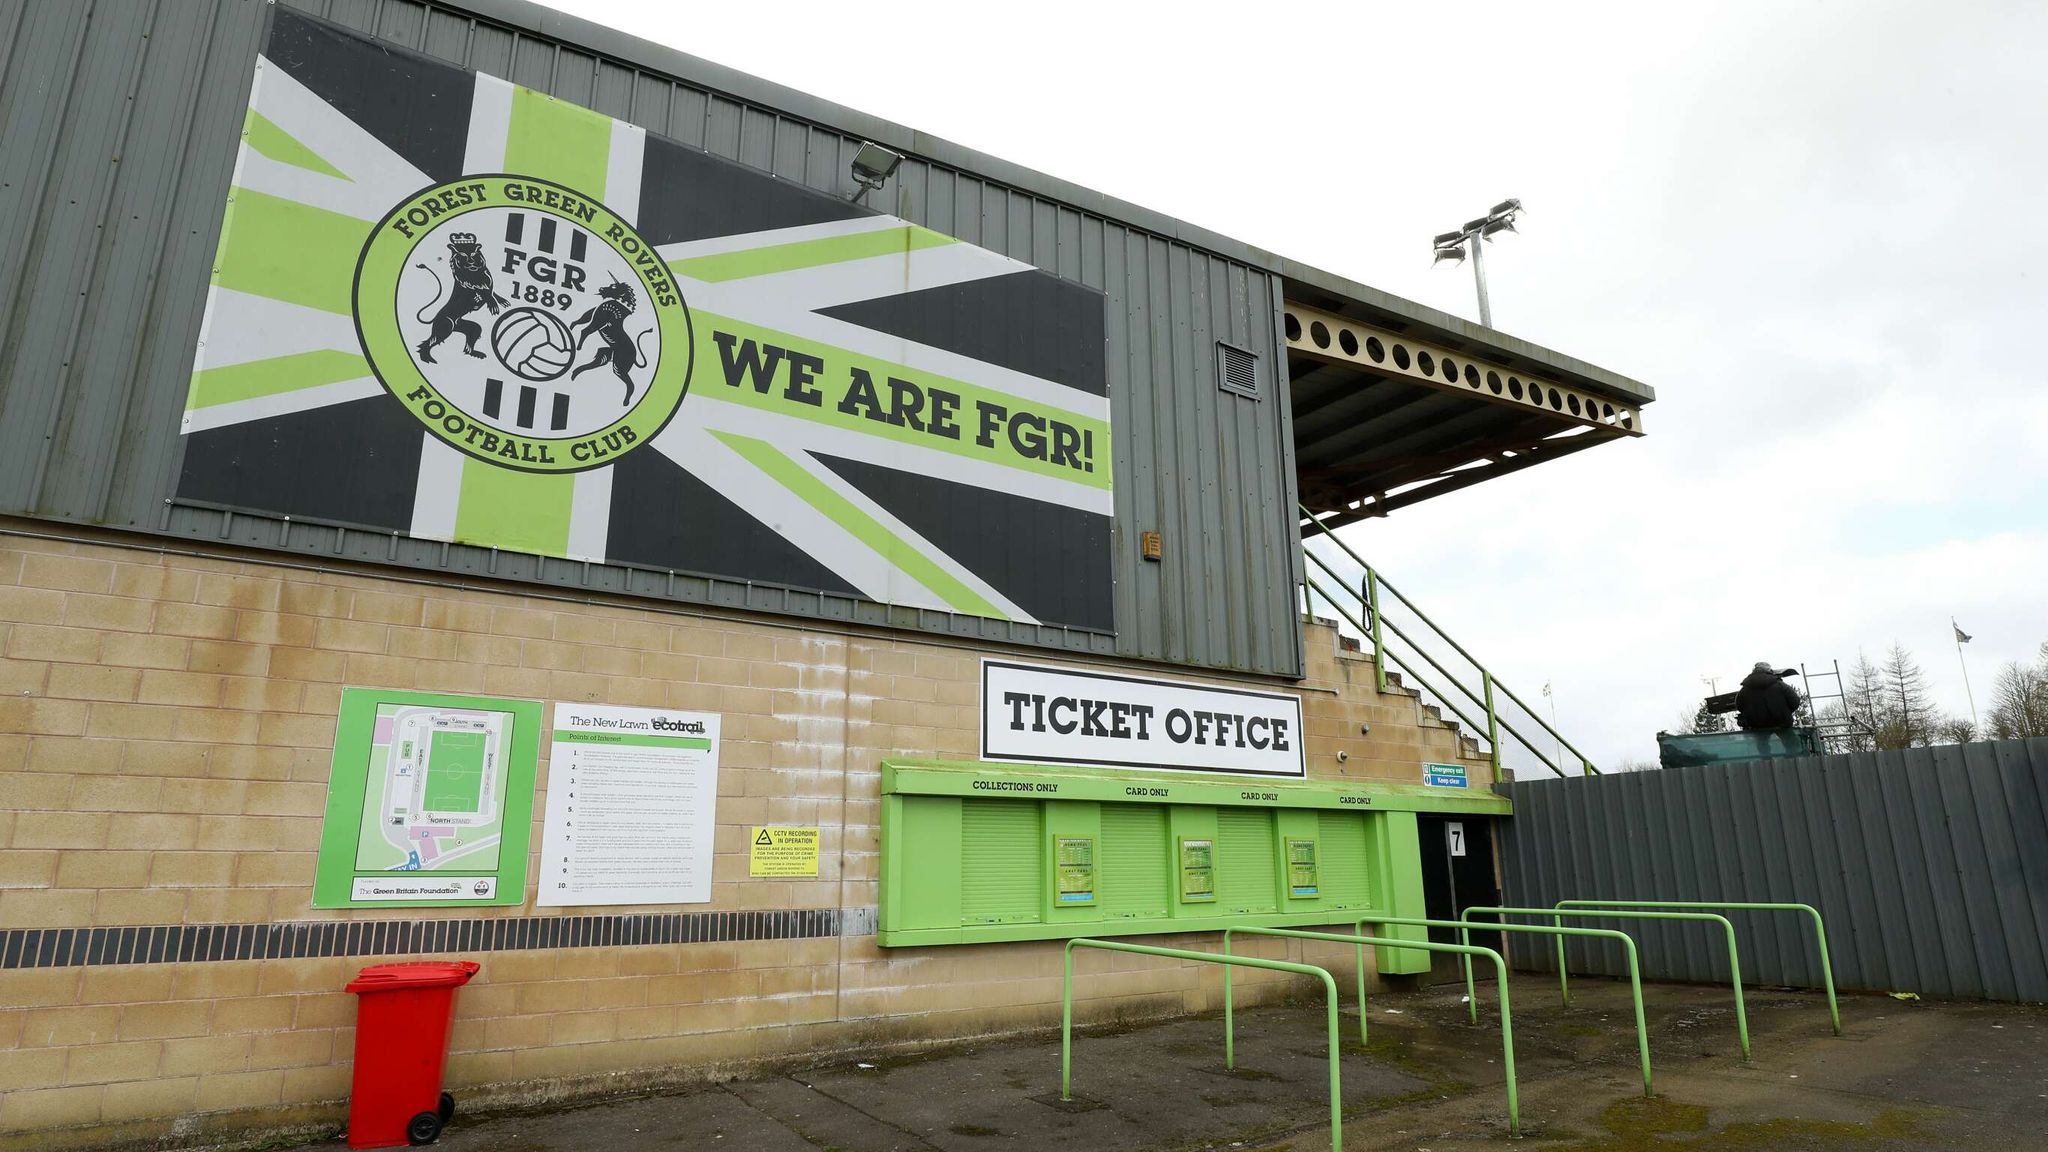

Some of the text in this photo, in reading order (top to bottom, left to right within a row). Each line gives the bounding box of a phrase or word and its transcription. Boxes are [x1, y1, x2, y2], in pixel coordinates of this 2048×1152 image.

[392, 183, 677, 308] FOREST GREEN ROVERS
[501, 246, 588, 292] FGR
[511, 281, 573, 312] 1889
[713, 331, 1094, 473] WE ARE FGR!
[406, 384, 638, 464] FOOTBALL CLUB
[570, 716, 704, 733] The New Lawn ecotrail
[1004, 691, 1289, 752] TICKET OFFICE
[569, 733, 622, 743] Points of Interest
[1431, 765, 1455, 775] Emergency
[972, 780, 1059, 793] COLLECTIONS ONLY
[1437, 777, 1449, 785] Keep
[1125, 786, 1169, 798] CARD ONLY
[1241, 792, 1279, 802] CARD ONLY
[1339, 796, 1372, 806] CARD ONLY
[1451, 831, 1461, 851] 7
[419, 887, 459, 895] Foundation
